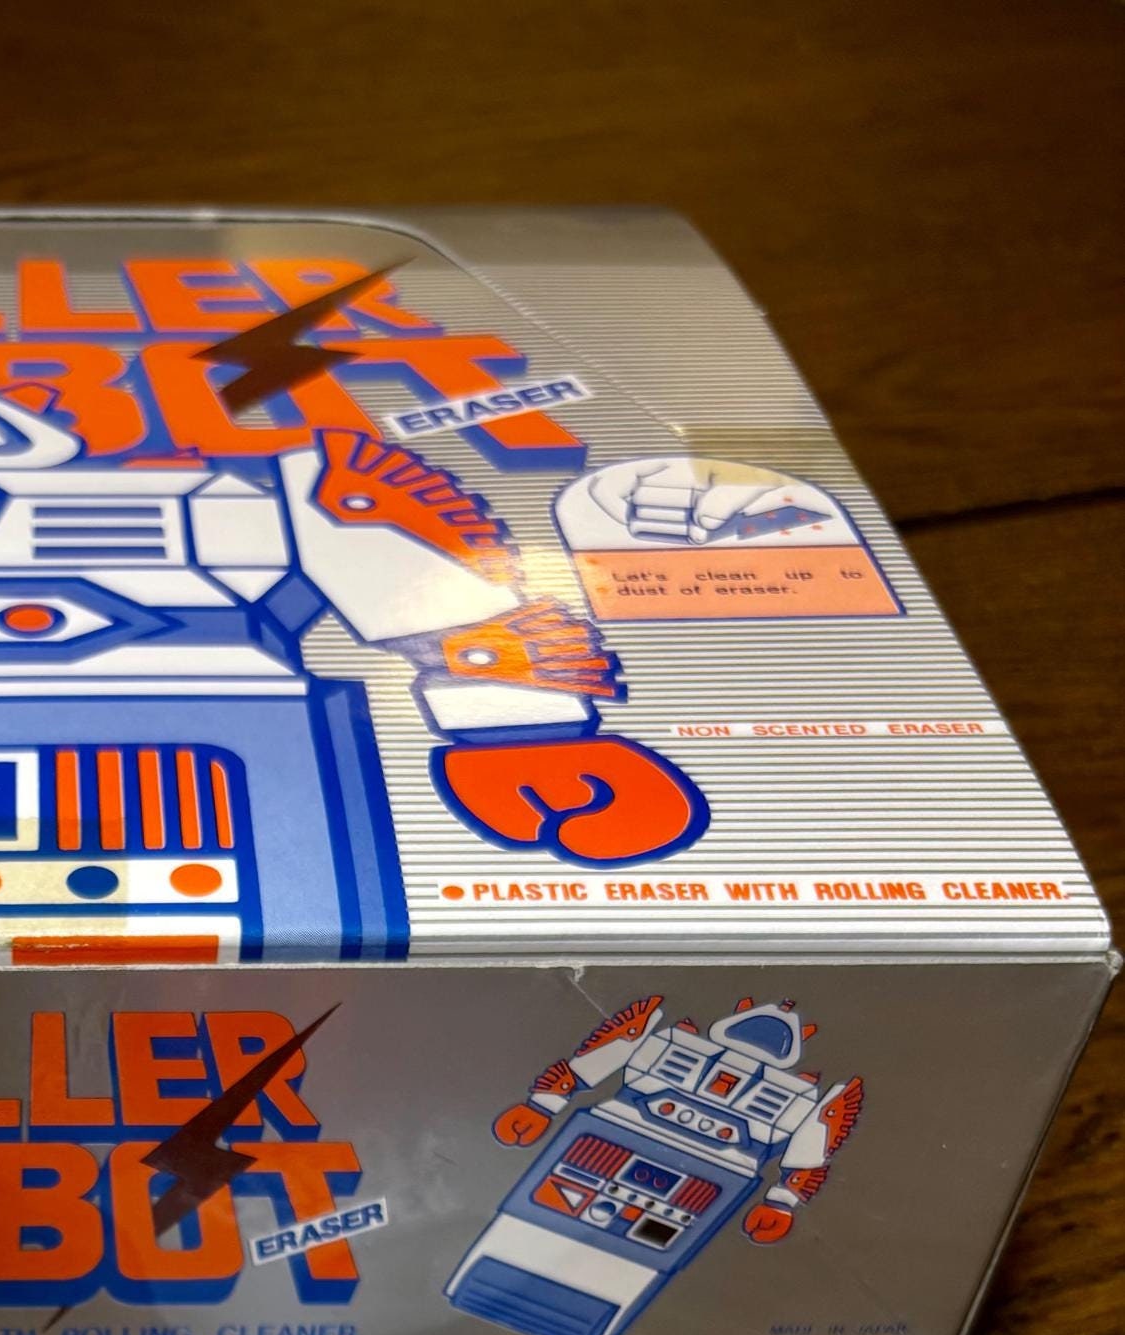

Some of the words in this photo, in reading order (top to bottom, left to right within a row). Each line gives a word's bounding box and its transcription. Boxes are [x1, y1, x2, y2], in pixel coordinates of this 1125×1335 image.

[397, 379, 584, 434] ERASER
[612, 571, 668, 582] Let's
[694, 570, 756, 582] clean
[784, 571, 813, 583] up
[840, 569, 863, 580] to
[616, 585, 668, 596] dust
[680, 585, 701, 596] of
[714, 585, 797, 596] eraser.
[676, 725, 731, 738] NON
[752, 724, 867, 737] SCENTED
[887, 722, 985, 736] ERASER
[472, 882, 588, 901] PLASTIC
[604, 882, 710, 901] ERASER
[724, 882, 799, 901] WITH
[813, 881, 927, 901] ROLLING
[254, 1202, 386, 1264] ERASER
